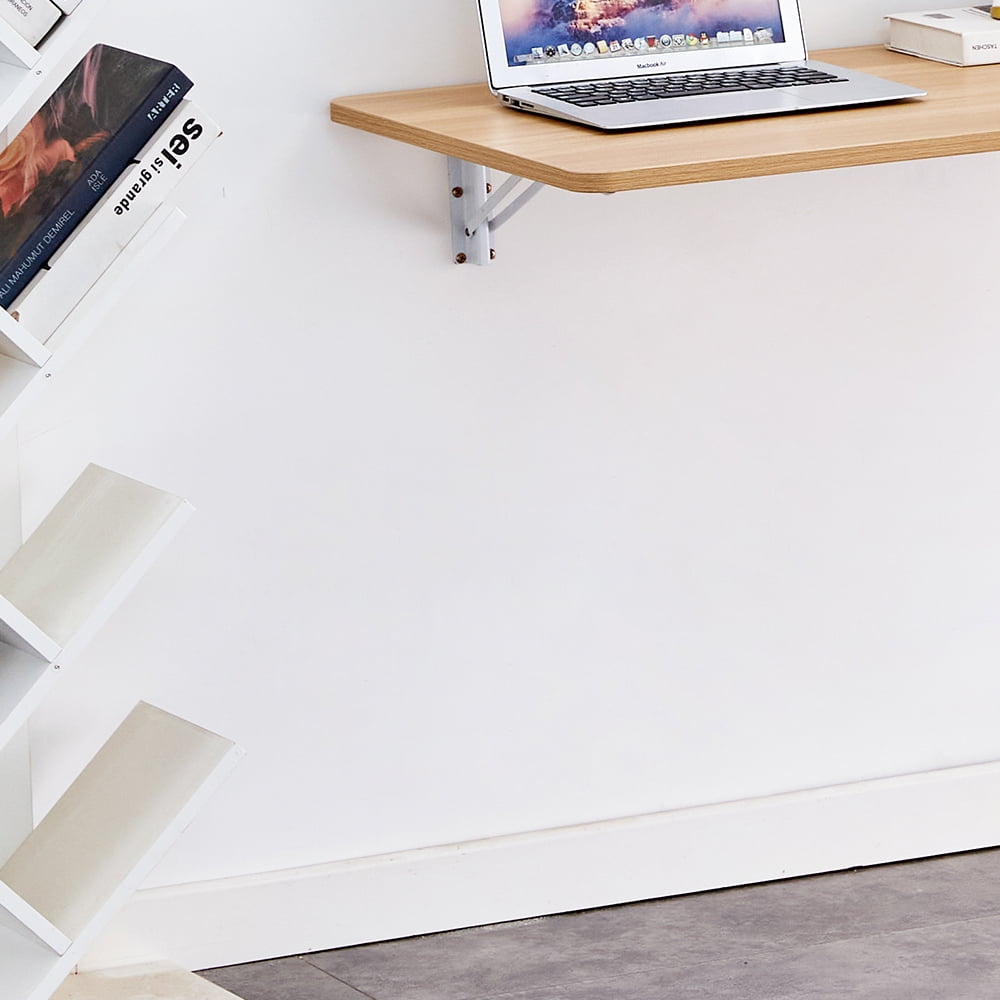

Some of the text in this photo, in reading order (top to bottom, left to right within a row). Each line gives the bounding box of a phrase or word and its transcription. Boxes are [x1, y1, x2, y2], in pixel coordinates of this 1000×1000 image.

[87, 169, 102, 187] ADA
[91, 174, 108, 192] ISLE
[113, 118, 203, 216] sei si grande
[9, 241, 45, 287] MAHUMUT
